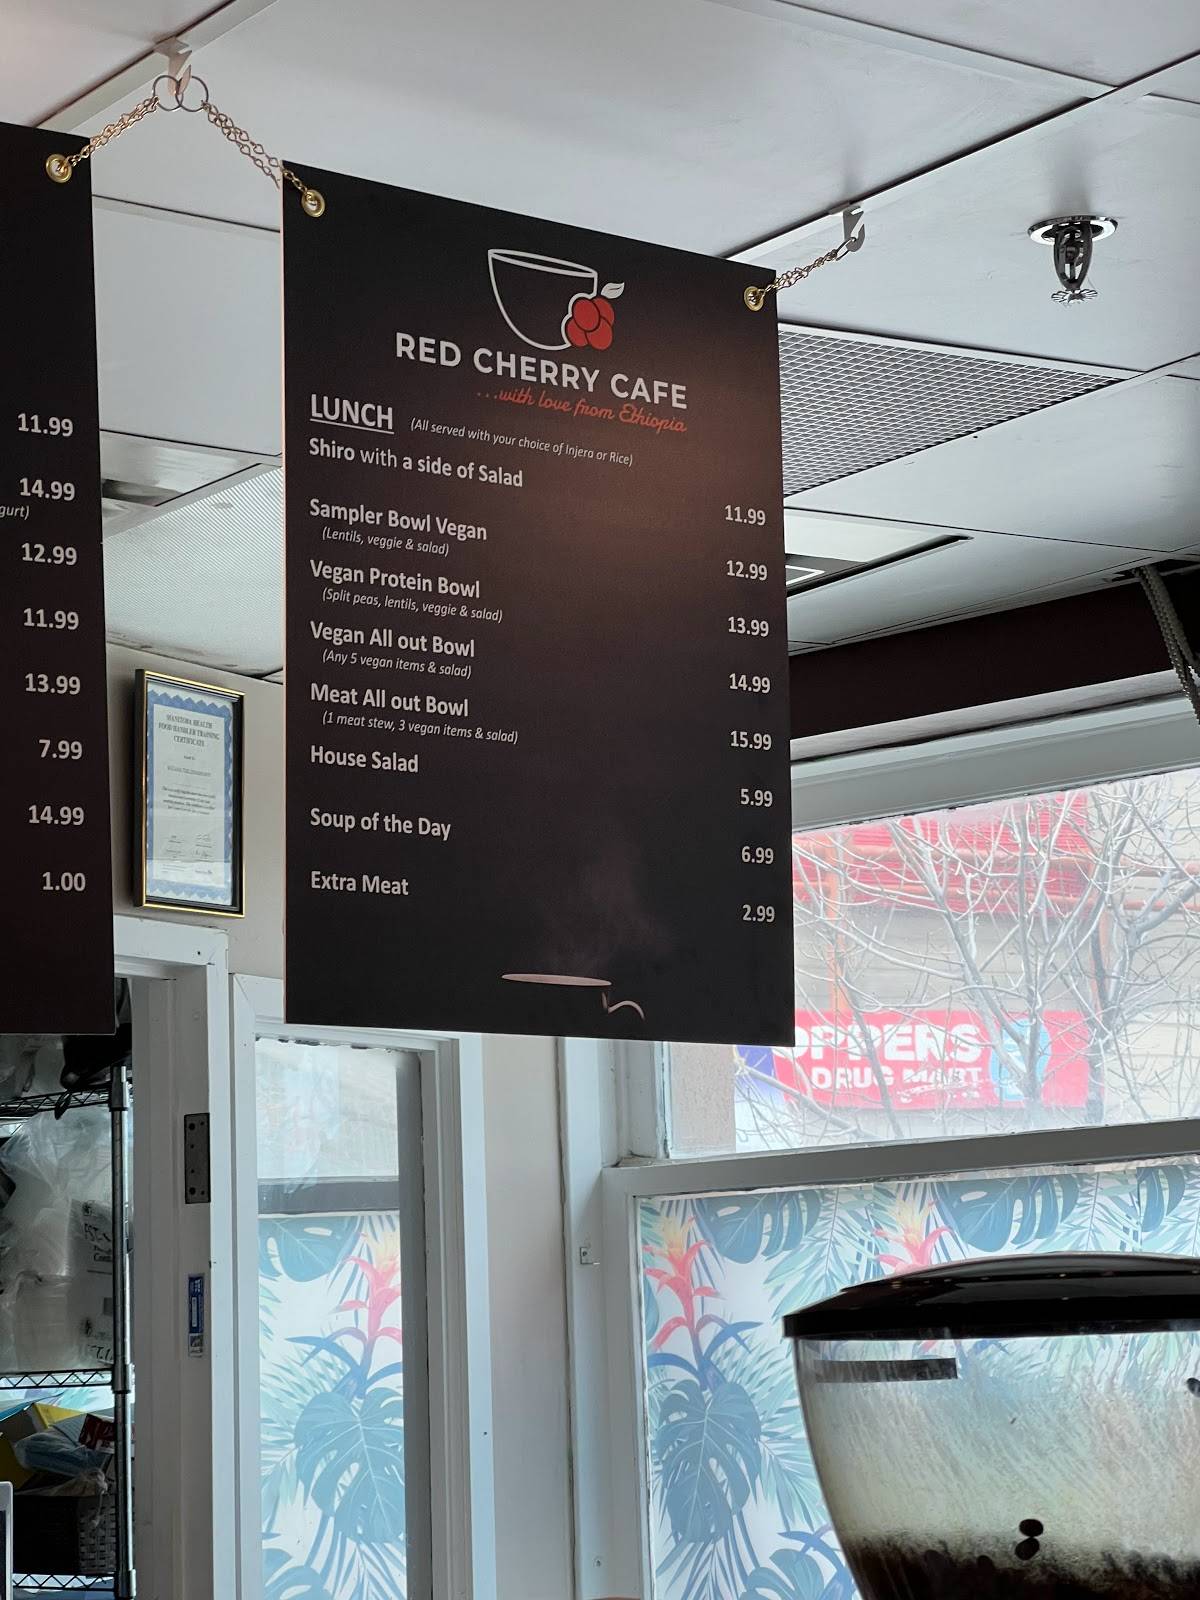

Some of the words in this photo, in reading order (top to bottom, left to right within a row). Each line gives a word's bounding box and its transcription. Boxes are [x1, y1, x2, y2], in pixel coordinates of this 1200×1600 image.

[396, 332, 462, 368] RED
[473, 347, 600, 393] CHERRY
[609, 373, 688, 409] CAFE
[310, 393, 395, 435] LUNCH
[538, 390, 572, 412] love
[573, 399, 616, 419] from
[618, 403, 688, 433] Ethiopia
[16, 412, 74, 438] 11.99
[410, 417, 430, 432] (All
[430, 422, 466, 437] served
[467, 428, 491, 442] with
[492, 433, 517, 446] your
[518, 437, 551, 452] choice
[552, 443, 566, 456] of
[565, 444, 595, 460] Injera
[596, 451, 609, 461] or
[609, 451, 633, 467] Rice)
[309, 437, 355, 461] Shiro
[359, 448, 398, 468] with
[402, 456, 413, 471] a
[417, 455, 452, 476] side
[456, 462, 475, 480] of
[478, 465, 524, 488] Salad
[19, 476, 76, 501] 14.99
[310, 498, 384, 526] Sampler
[388, 509, 431, 533] Bowl
[435, 517, 488, 542] Vegan
[724, 504, 766, 526] 11.99
[20, 542, 78, 567] 12.99
[322, 526, 364, 545] (Lentils,
[367, 534, 403, 550] veggie
[405, 538, 414, 550] &
[416, 540, 449, 557] salad)
[310, 559, 365, 585] Vegan
[369, 567, 433, 593] Protein
[437, 576, 481, 599] Bowl
[726, 559, 768, 581] 12.99
[322, 587, 351, 603] (Split
[352, 593, 382, 608] peas,
[384, 595, 420, 612] lentils,
[422, 602, 457, 617] veggie
[459, 605, 469, 617] &
[471, 607, 503, 624] salad)
[22, 607, 80, 631] 11.99
[728, 616, 770, 638] 13.99
[310, 620, 365, 646] Vegan
[369, 628, 393, 648] All
[397, 634, 428, 652] out
[432, 635, 476, 658] Bowl
[322, 648, 349, 665] (Any
[350, 653, 358, 665] 5
[360, 656, 393, 670] vegan
[395, 658, 425, 673] items
[427, 661, 437, 674] &
[439, 662, 473, 680] salad)
[24, 673, 82, 696] 13.99
[729, 672, 771, 694] 14.99
[310, 682, 359, 705] Meat
[362, 688, 386, 709] All
[390, 694, 421, 712] out
[425, 695, 470, 717] Bowl
[322, 710, 334, 725] (1
[336, 715, 366, 728] meat
[368, 718, 396, 732] stew,
[398, 720, 406, 732] 3
[408, 724, 442, 737] vegan
[443, 724, 473, 739] items
[475, 727, 484, 740] &
[485, 729, 519, 745] salad)
[730, 730, 772, 751] 15.99
[38, 738, 83, 760] 7.99
[310, 745, 368, 768] House
[371, 751, 420, 773] Salad
[740, 788, 773, 808] 5.99
[27, 805, 85, 827] 14.99
[310, 807, 356, 833] Soup
[360, 812, 380, 831] of
[383, 813, 413, 834] the
[418, 817, 451, 841] Day
[741, 845, 775, 865] 6.99
[41, 871, 86, 893] 1.00
[311, 870, 357, 892] Extra
[362, 874, 409, 896] Meat
[742, 904, 776, 923] 2.99
[811, 1066, 894, 1090] DRUG
